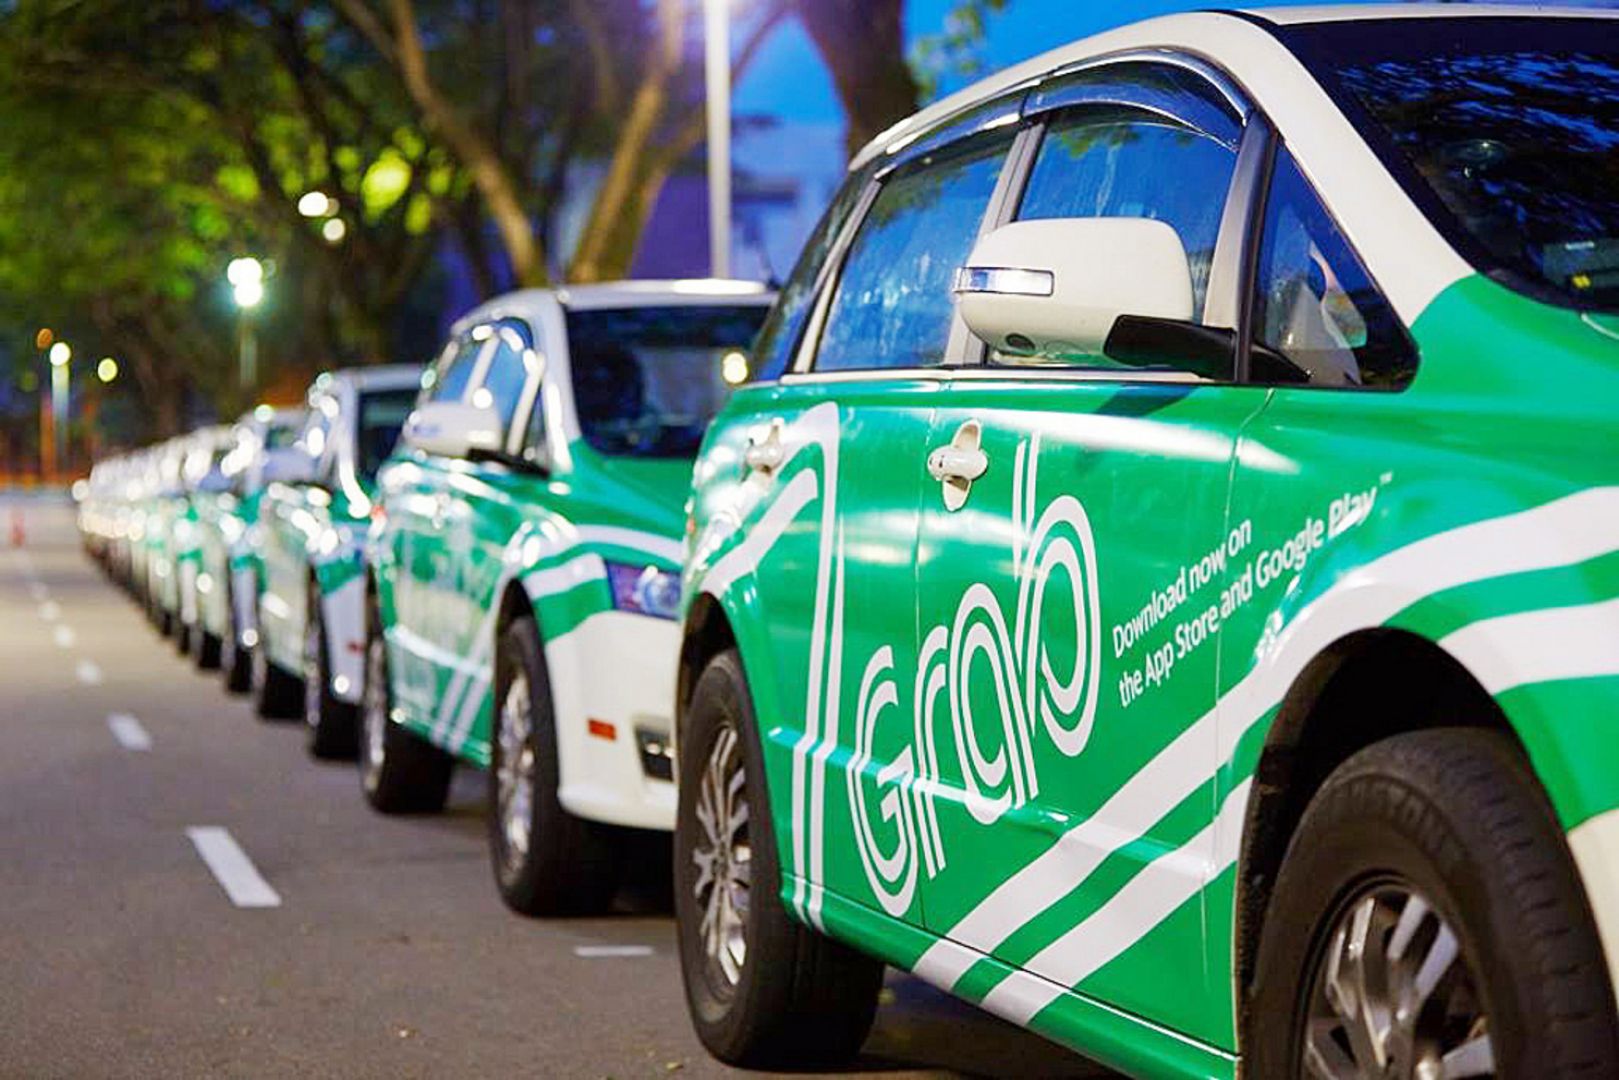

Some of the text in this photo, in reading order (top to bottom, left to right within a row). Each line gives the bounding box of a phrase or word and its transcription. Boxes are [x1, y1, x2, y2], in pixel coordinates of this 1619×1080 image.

[846, 432, 1101, 917] Grab
[1112, 518, 1252, 659] Download now on
[1118, 671, 1144, 708] the
[1145, 640, 1174, 689] App
[1174, 608, 1221, 660] Store
[1220, 562, 1252, 620] and
[1255, 517, 1324, 589] Google
